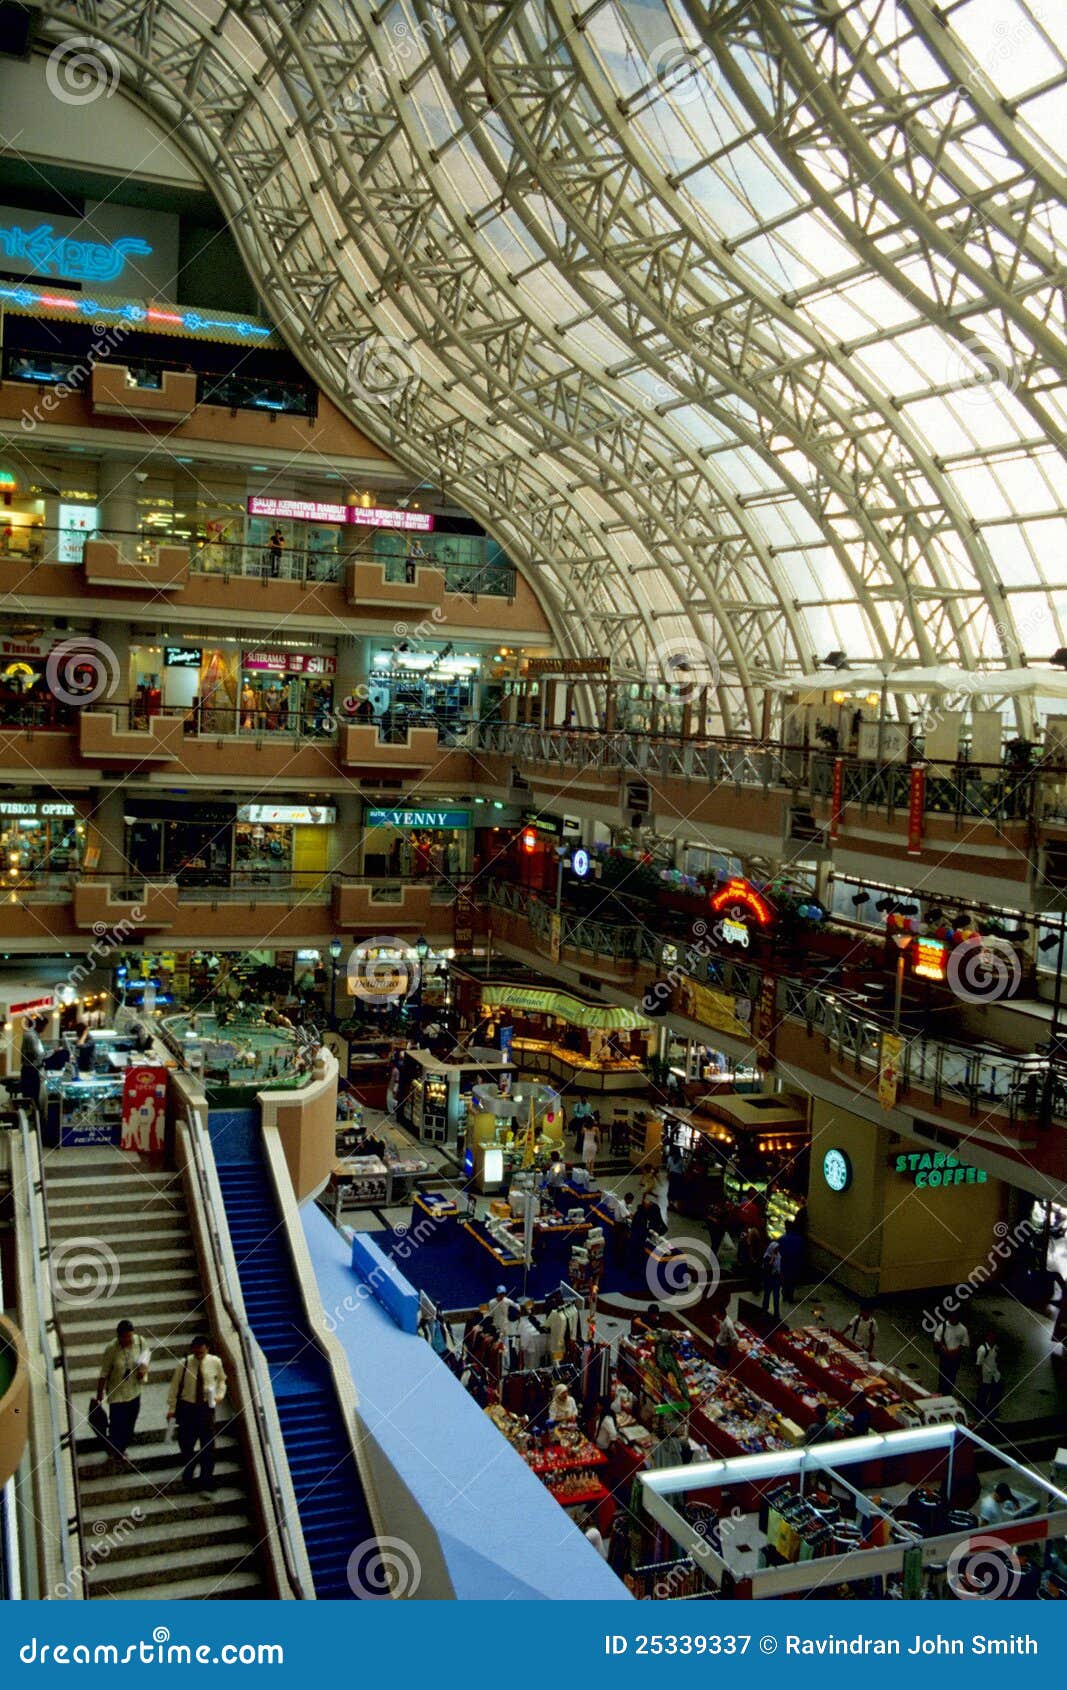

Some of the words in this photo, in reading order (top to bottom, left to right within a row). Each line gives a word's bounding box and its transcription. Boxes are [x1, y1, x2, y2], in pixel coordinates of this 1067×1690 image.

[248, 652, 286, 664] SUTERAMAS
[0, 803, 36, 815] VISION
[41, 804, 74, 816] OPTIK
[393, 812, 447, 826] YENNY
[896, 1152, 968, 1172] STARB
[915, 1167, 987, 1188] COFFEE
